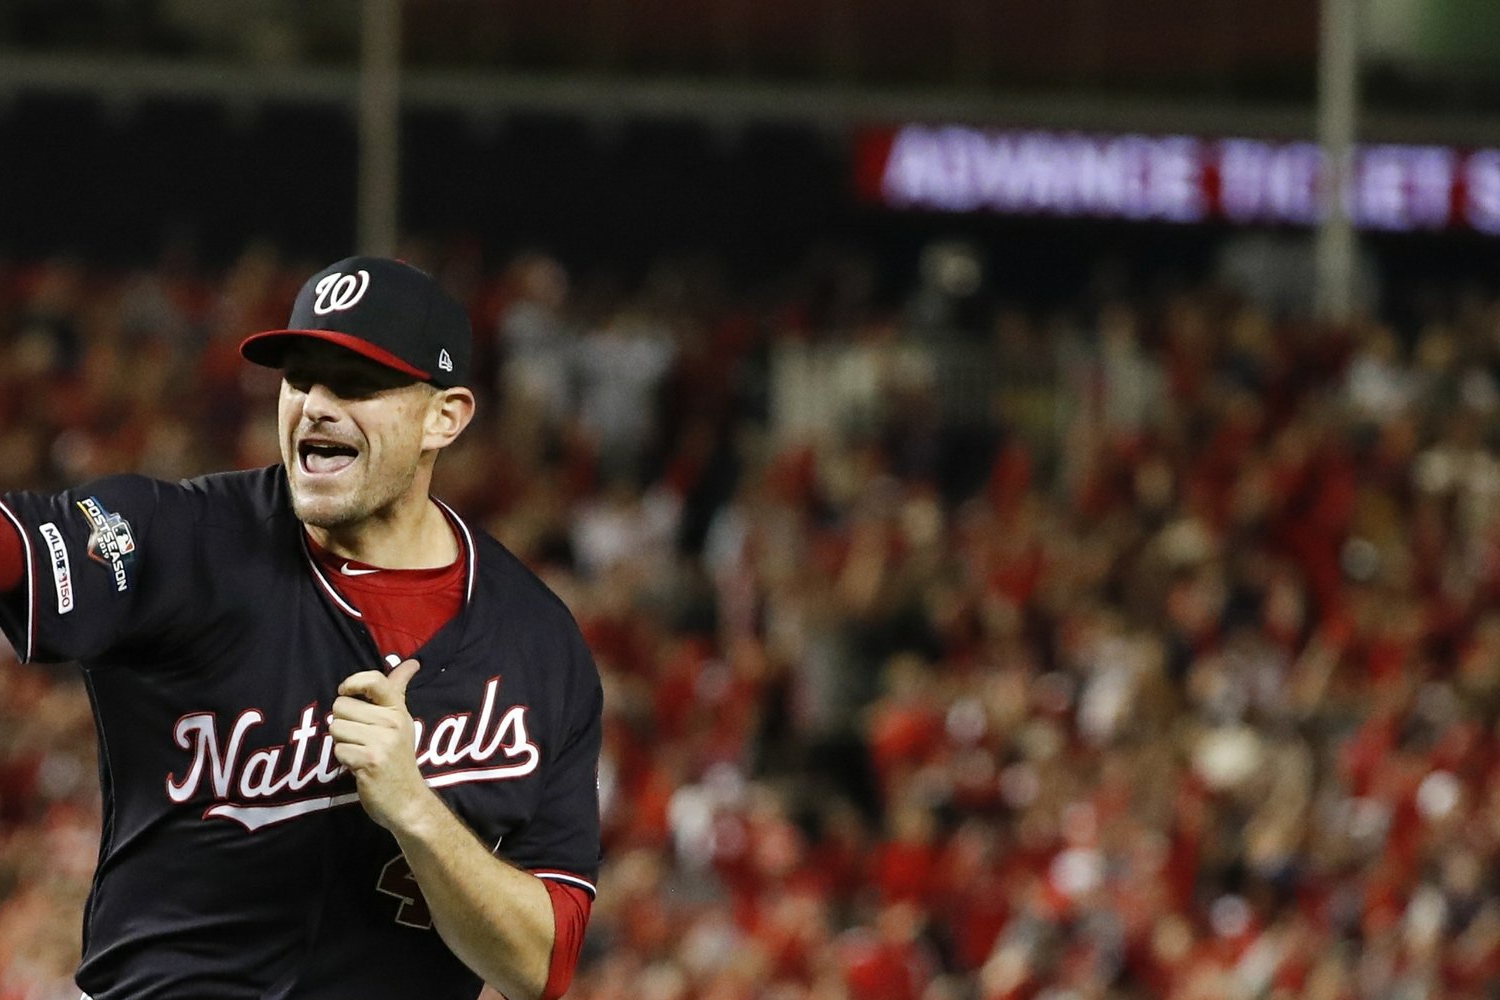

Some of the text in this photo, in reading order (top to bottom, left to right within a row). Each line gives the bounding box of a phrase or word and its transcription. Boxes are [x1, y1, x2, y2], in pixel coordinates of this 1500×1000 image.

[1214, 137, 1452, 229] TICET
[313, 269, 371, 315] W
[45, 528, 71, 608] MLB 150
[81, 498, 128, 592] POSTSEASON
[166, 675, 540, 804] Natials
